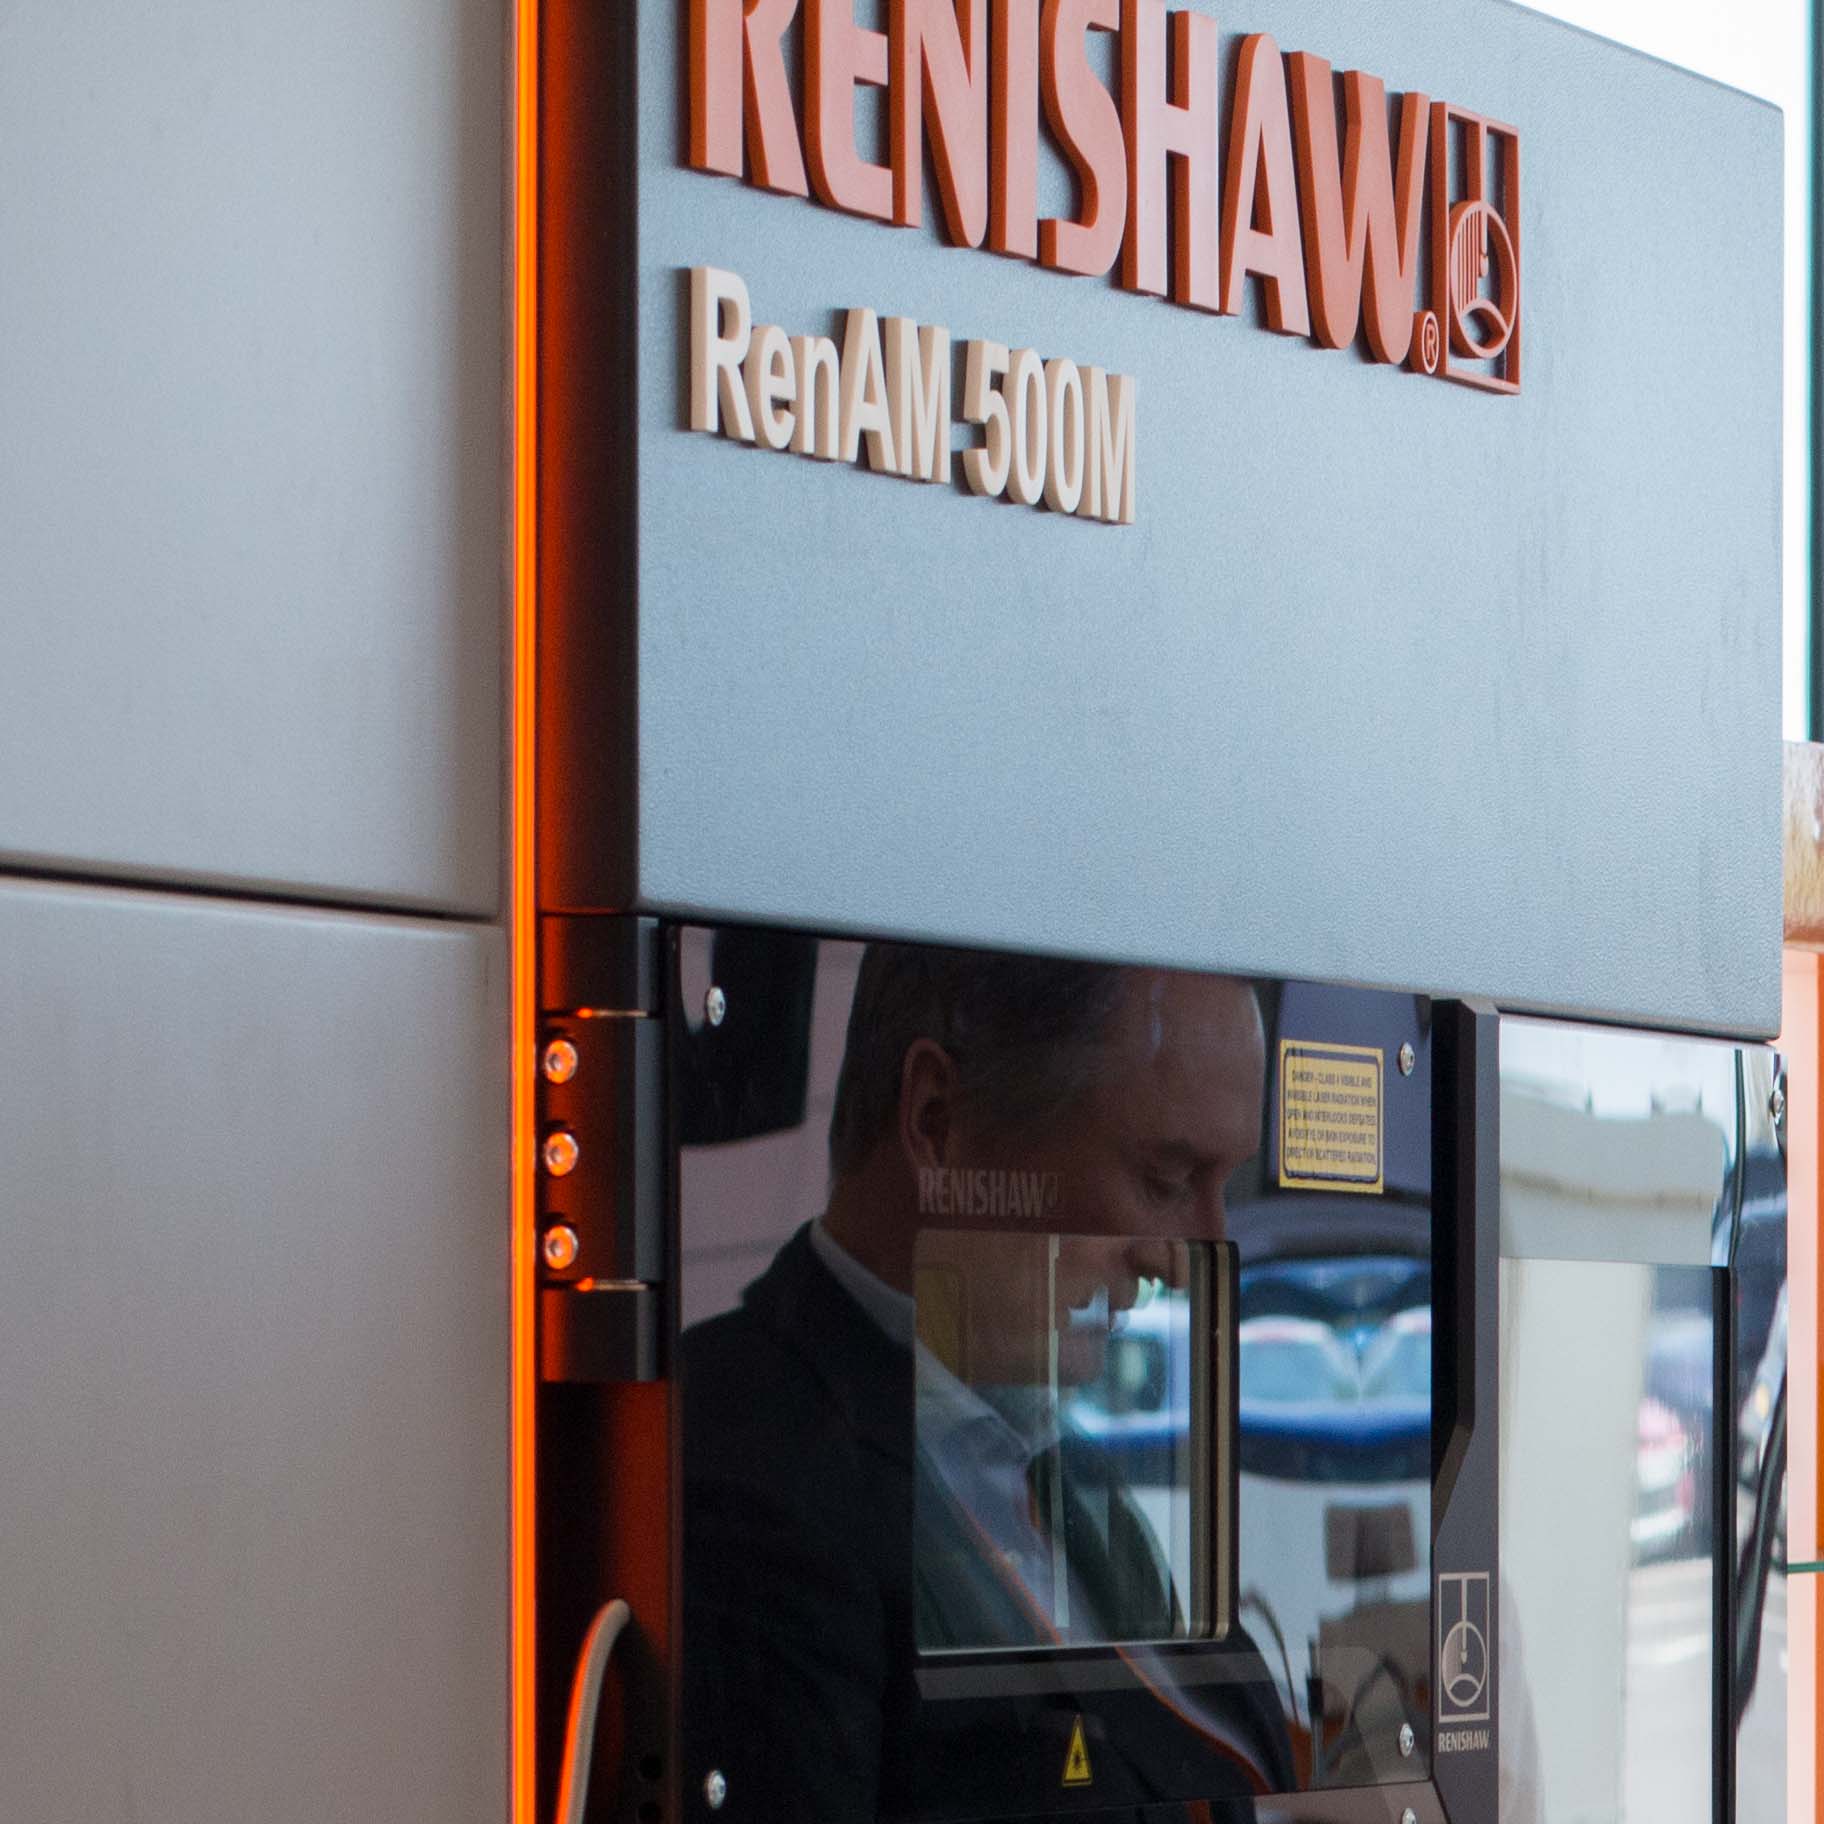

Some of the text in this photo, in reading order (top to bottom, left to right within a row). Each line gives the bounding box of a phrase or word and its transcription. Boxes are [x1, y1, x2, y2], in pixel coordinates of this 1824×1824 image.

[689, 266, 1136, 525] RenAM 500M
[918, 1167, 1046, 1218] RENISHAW
[1438, 1729, 1490, 1753] RENISHAW
